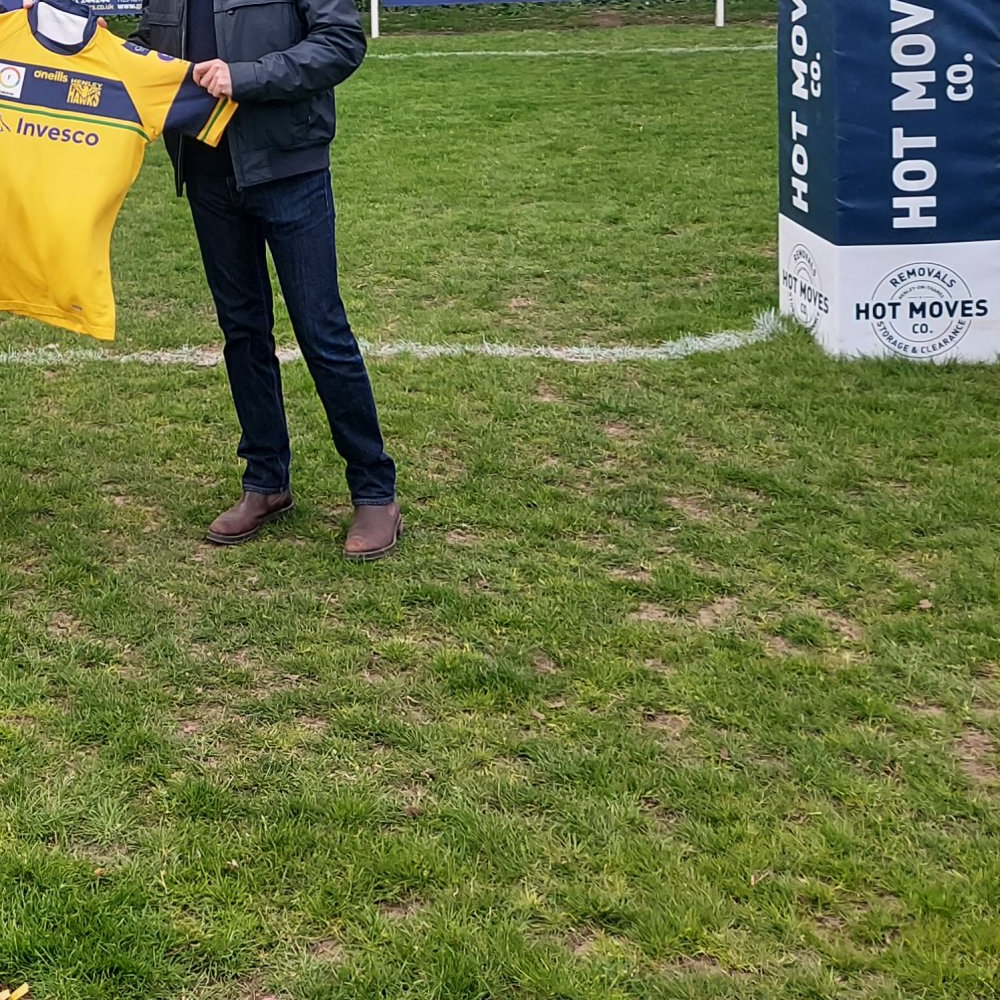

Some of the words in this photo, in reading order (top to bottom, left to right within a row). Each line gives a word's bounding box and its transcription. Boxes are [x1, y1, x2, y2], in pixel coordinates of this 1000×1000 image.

[71, 78, 104, 89] HENLEY
[809, 51, 822, 98] CO.
[946, 53, 974, 102] CO.
[67, 87, 101, 108] HAWKS
[17, 117, 99, 146] Invesco
[791, 111, 809, 213] HOT
[892, 127, 937, 229] HOT
[782, 269, 798, 293] HOT
[800, 281, 829, 314] MOVES
[890, 267, 957, 288] REMOVALS
[855, 302, 901, 321] HOT
[909, 299, 988, 319] MOVES
[876, 321, 909, 352] STORAGE
[911, 346, 917, 354] &
[921, 319, 966, 354] CLEARANCE
[912, 323, 933, 334] CO.
